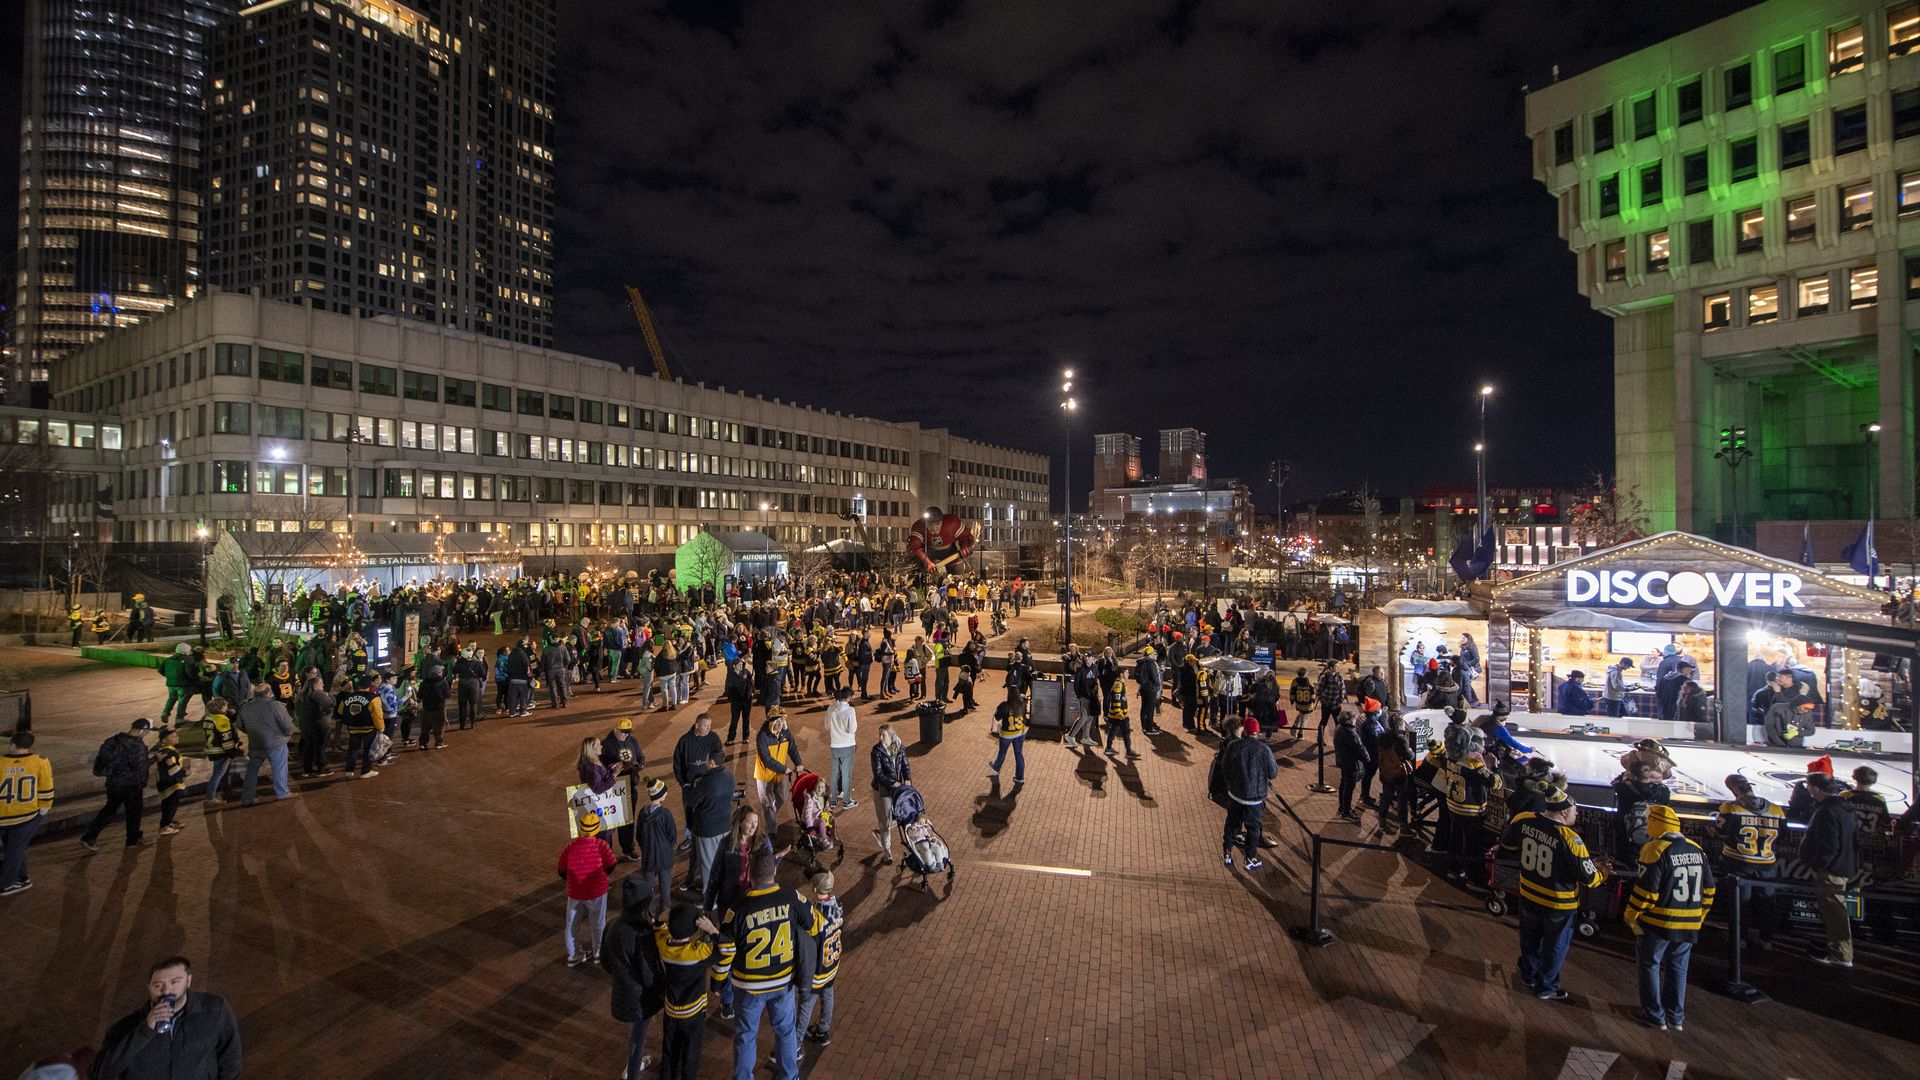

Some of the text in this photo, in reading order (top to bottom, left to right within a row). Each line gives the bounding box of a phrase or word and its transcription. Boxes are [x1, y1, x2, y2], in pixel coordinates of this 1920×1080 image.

[379, 556, 426, 565] STANLEY
[430, 556, 448, 564] CUP
[1567, 570, 1806, 607] DISCOVER
[344, 695, 369, 706] BOSTON
[0, 775, 37, 805] 40
[575, 794, 601, 807] LET'S
[1521, 824, 1559, 849] PASTRNAK
[1737, 826, 1779, 857] 37
[1521, 837, 1553, 878] 88
[1670, 852, 1703, 867] BERGERON
[1673, 865, 1701, 903] 37
[746, 903, 790, 929] O'REILLY
[745, 920, 794, 969] 24
[823, 929, 842, 967] 63
